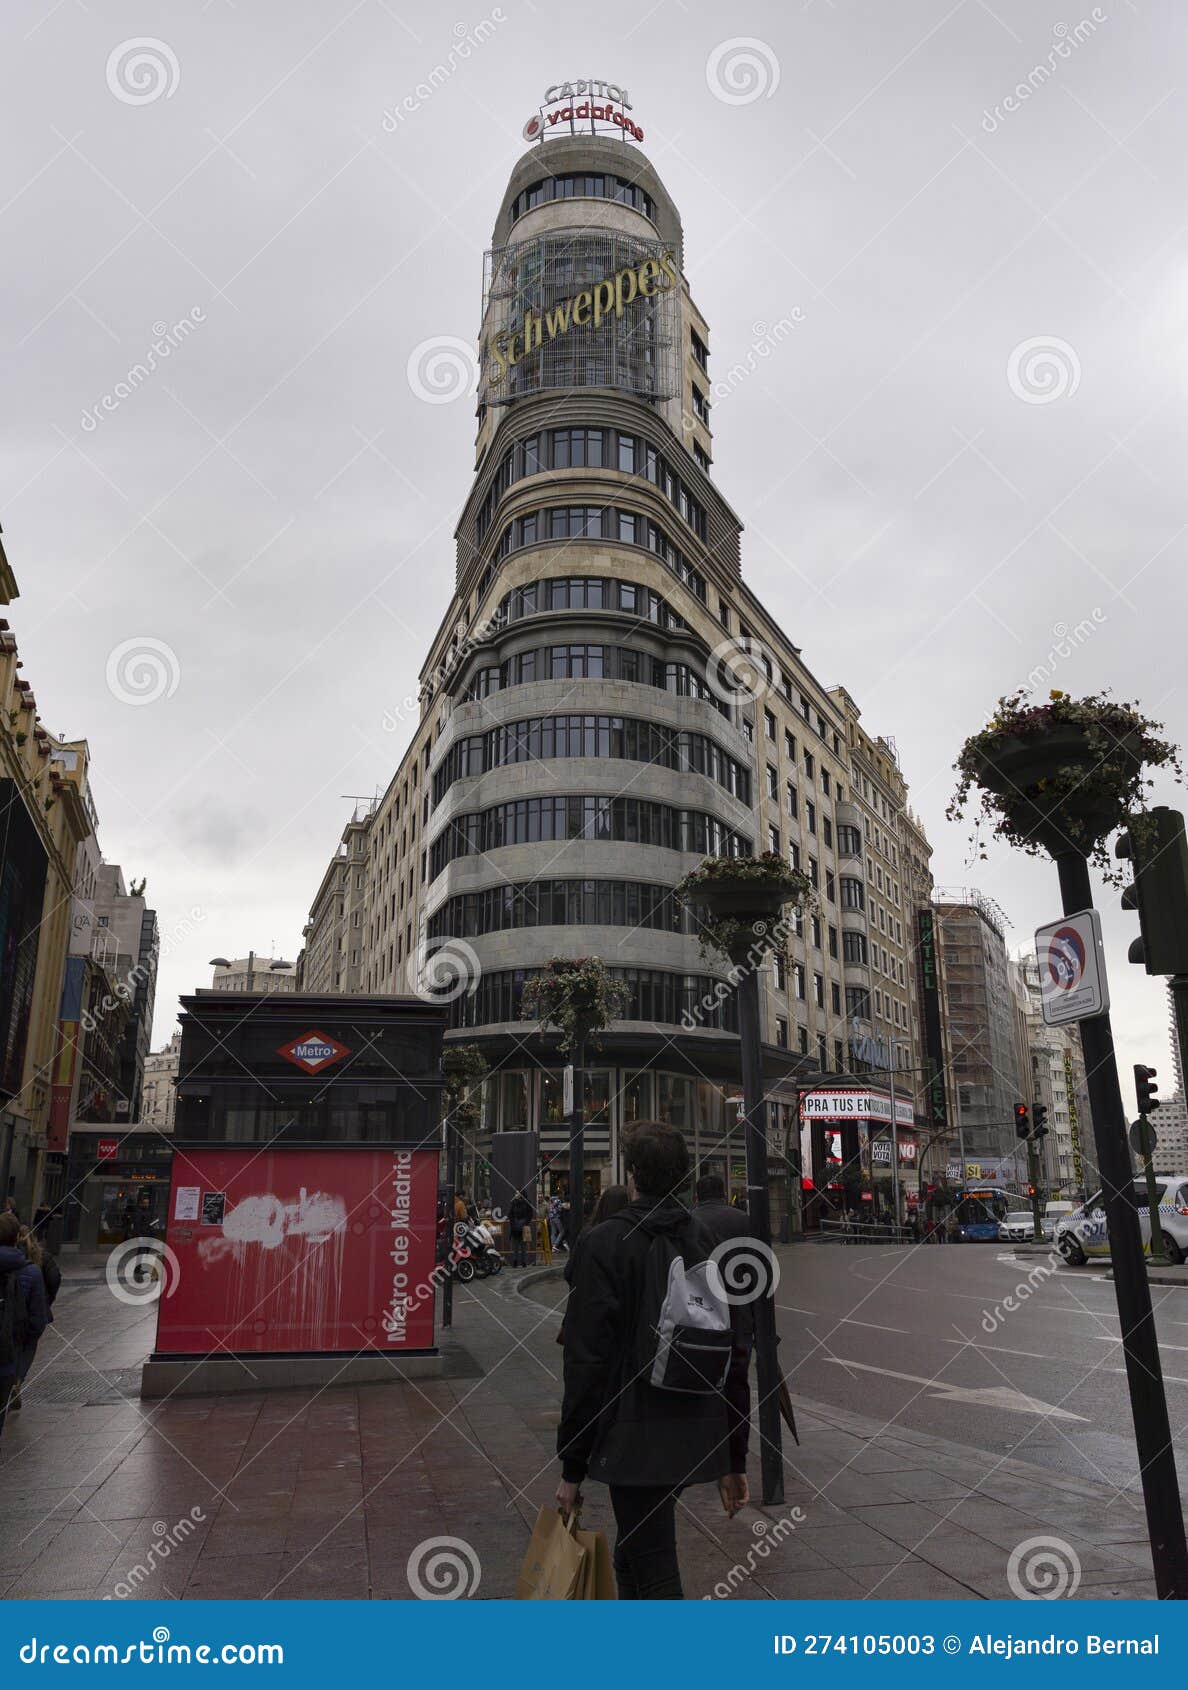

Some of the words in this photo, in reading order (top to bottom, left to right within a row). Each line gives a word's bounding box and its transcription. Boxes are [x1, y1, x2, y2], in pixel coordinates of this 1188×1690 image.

[544, 79, 632, 111] CAPITOL
[547, 101, 644, 142] vodafone
[487, 249, 677, 386] Schweppes
[920, 914, 935, 989] HOTEL
[296, 1044, 331, 1058] Metro
[832, 1098, 854, 1112] TUS
[873, 1143, 891, 1152] VOTA
[873, 1151, 891, 1161] VOTA
[898, 1144, 916, 1159] NO
[391, 1151, 412, 1229] Madrid
[391, 1236, 409, 1265] de
[387, 1283, 408, 1342] Metro
